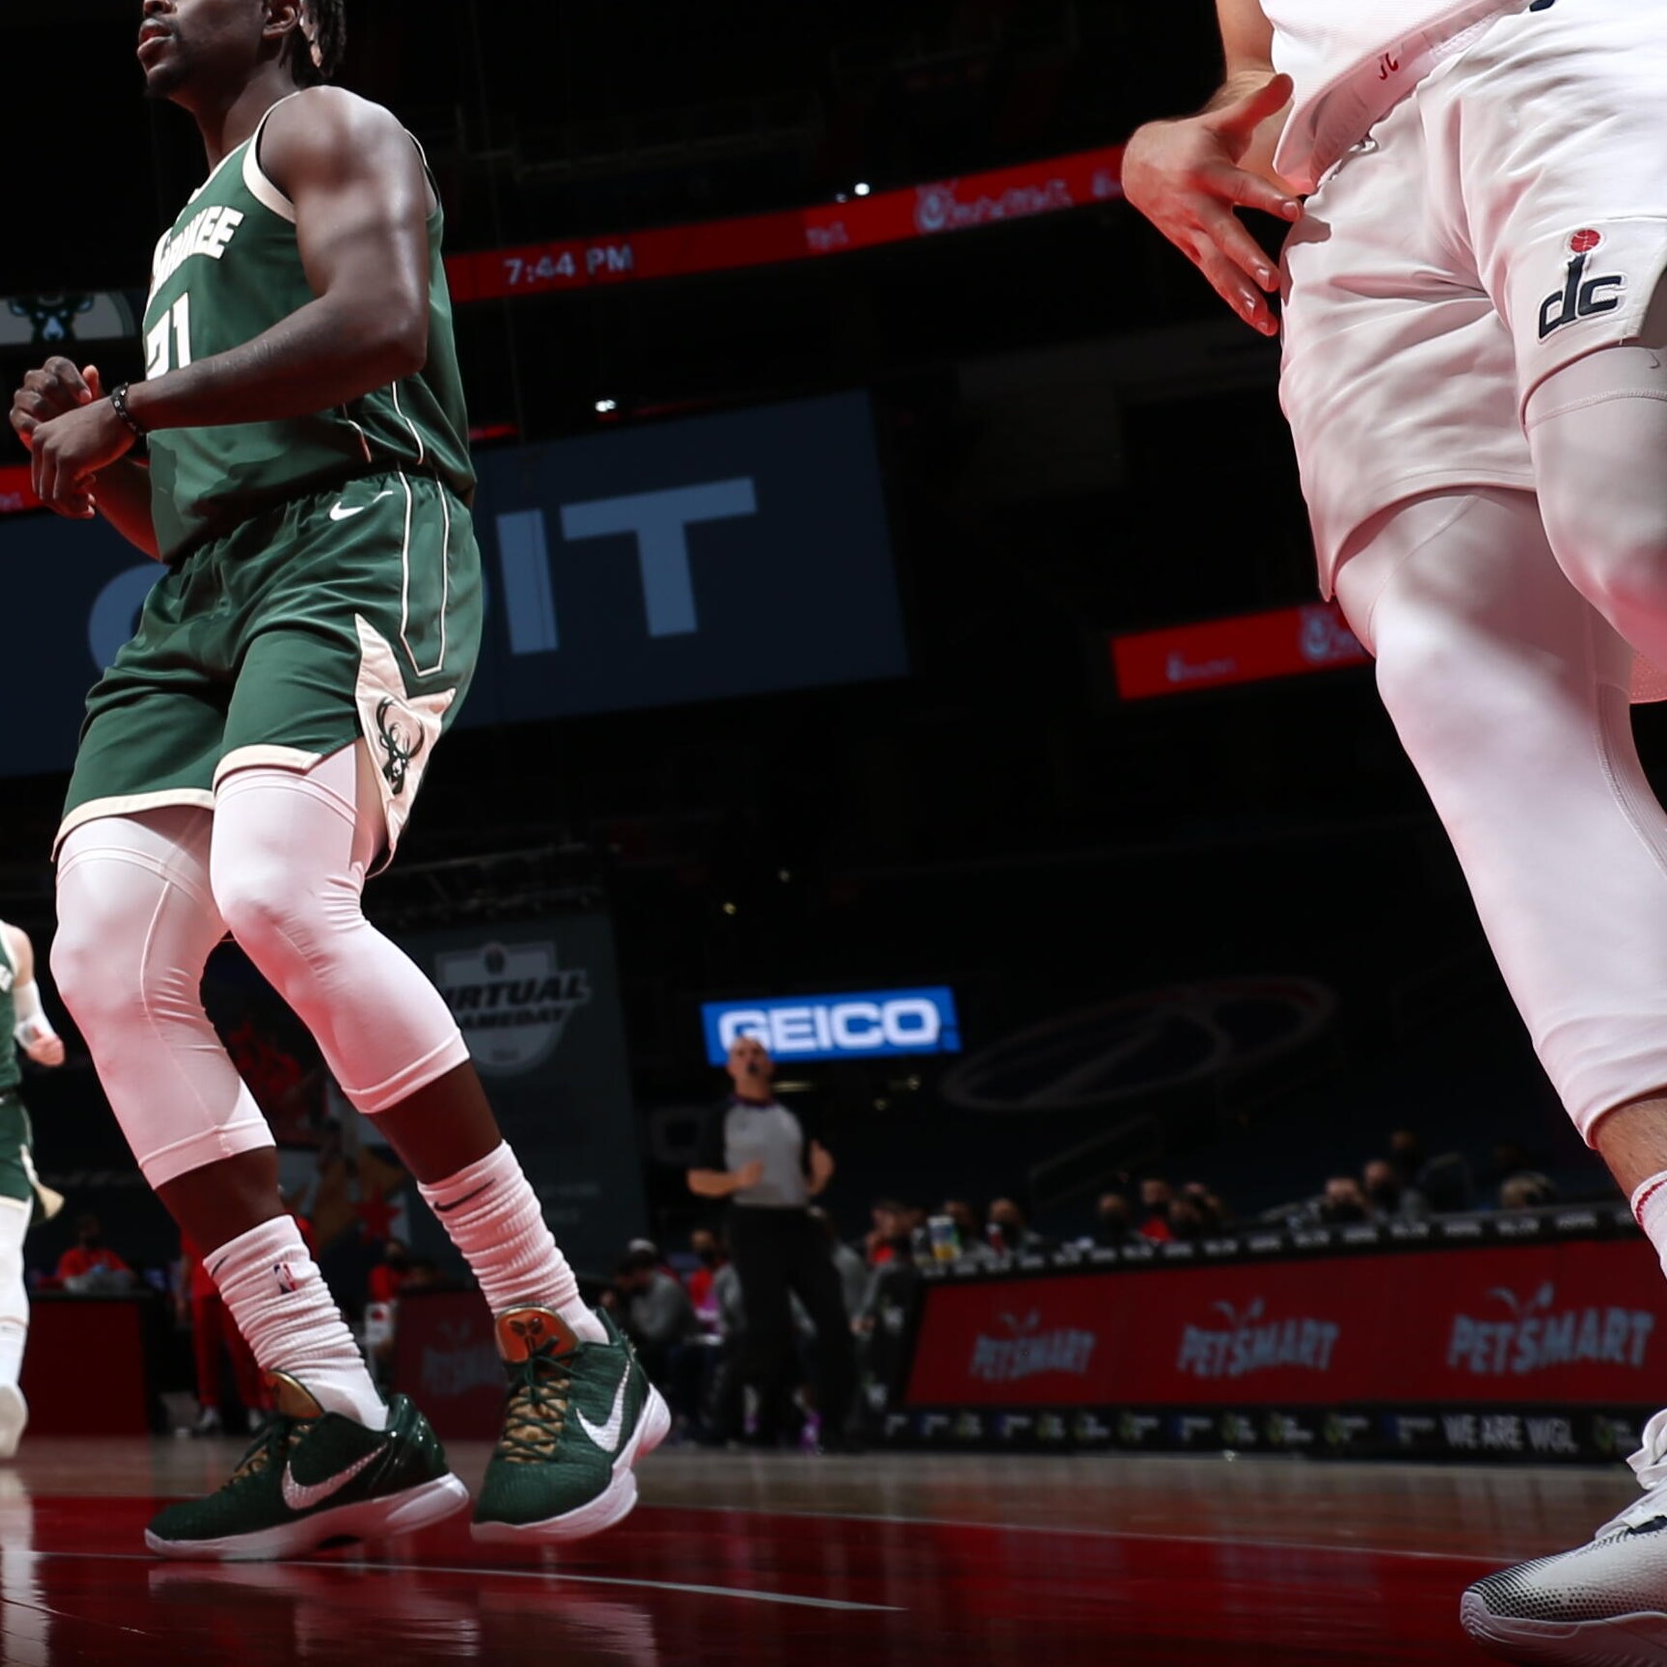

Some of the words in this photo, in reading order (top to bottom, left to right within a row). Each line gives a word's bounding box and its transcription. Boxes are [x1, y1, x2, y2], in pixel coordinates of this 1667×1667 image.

[503, 250, 578, 286] 7:44
[584, 244, 634, 277] PM
[441, 971, 586, 1012] IRTUAL
[717, 997, 942, 1054] GEICO
[1175, 1315, 1341, 1380] PETSMART
[1445, 1304, 1657, 1378] PETSMART
